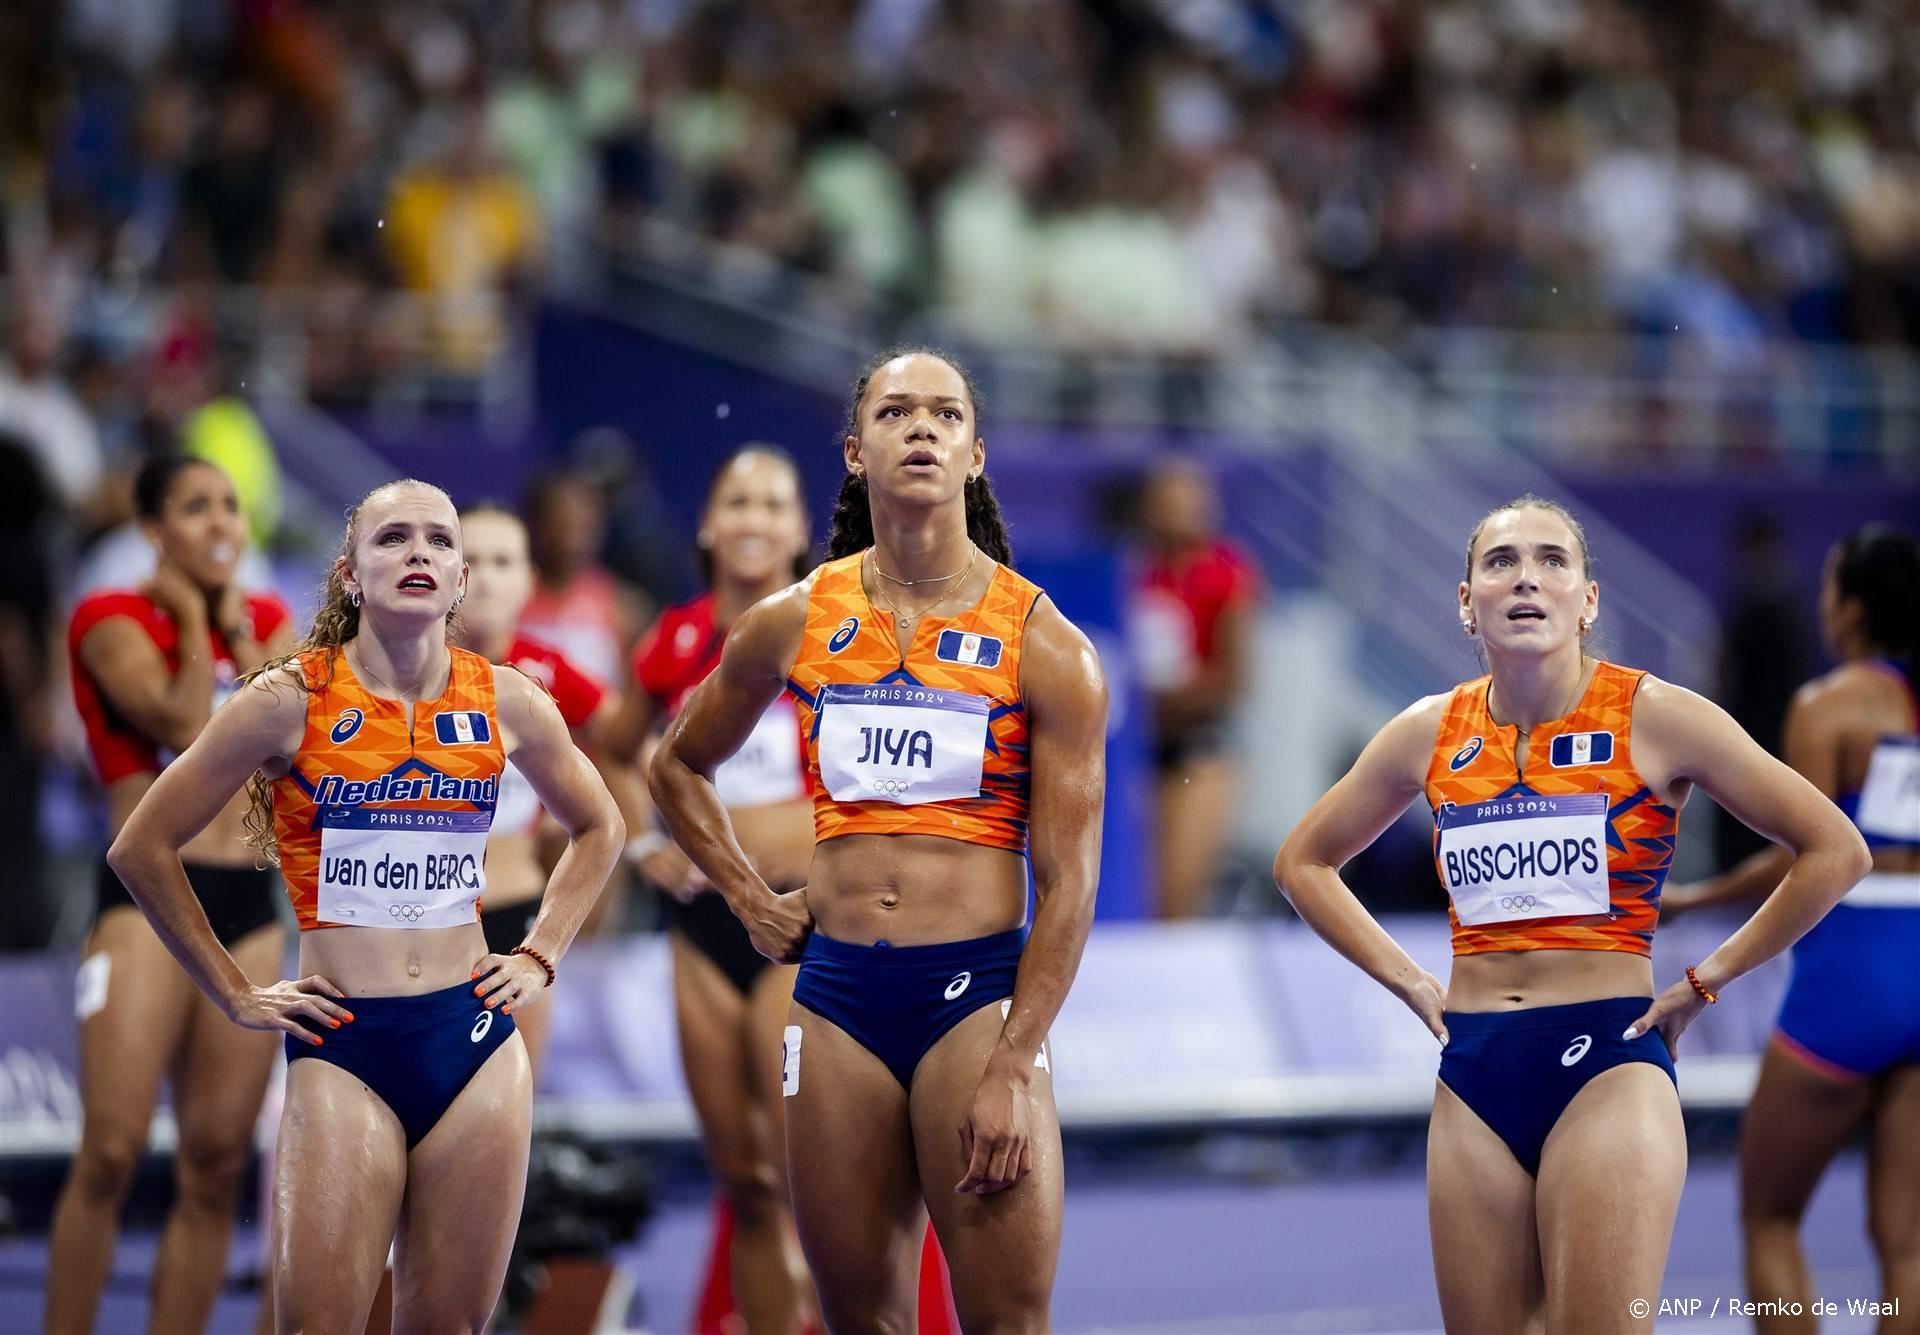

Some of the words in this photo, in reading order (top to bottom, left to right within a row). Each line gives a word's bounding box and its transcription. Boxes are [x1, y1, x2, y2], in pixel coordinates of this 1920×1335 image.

[864, 689, 901, 700] PARIS
[905, 691, 944, 704] 2024
[856, 727, 933, 769] JIYA
[313, 773, 496, 804] Nederland
[370, 813, 412, 825] PARIS
[417, 814, 453, 826] 2024
[1477, 804, 1513, 818] PARIS
[1518, 801, 1557, 813] 2024
[325, 856, 367, 887] van
[373, 853, 418, 889] den
[424, 853, 479, 890] BERG
[1446, 837, 1599, 887] BISSCHOPS
